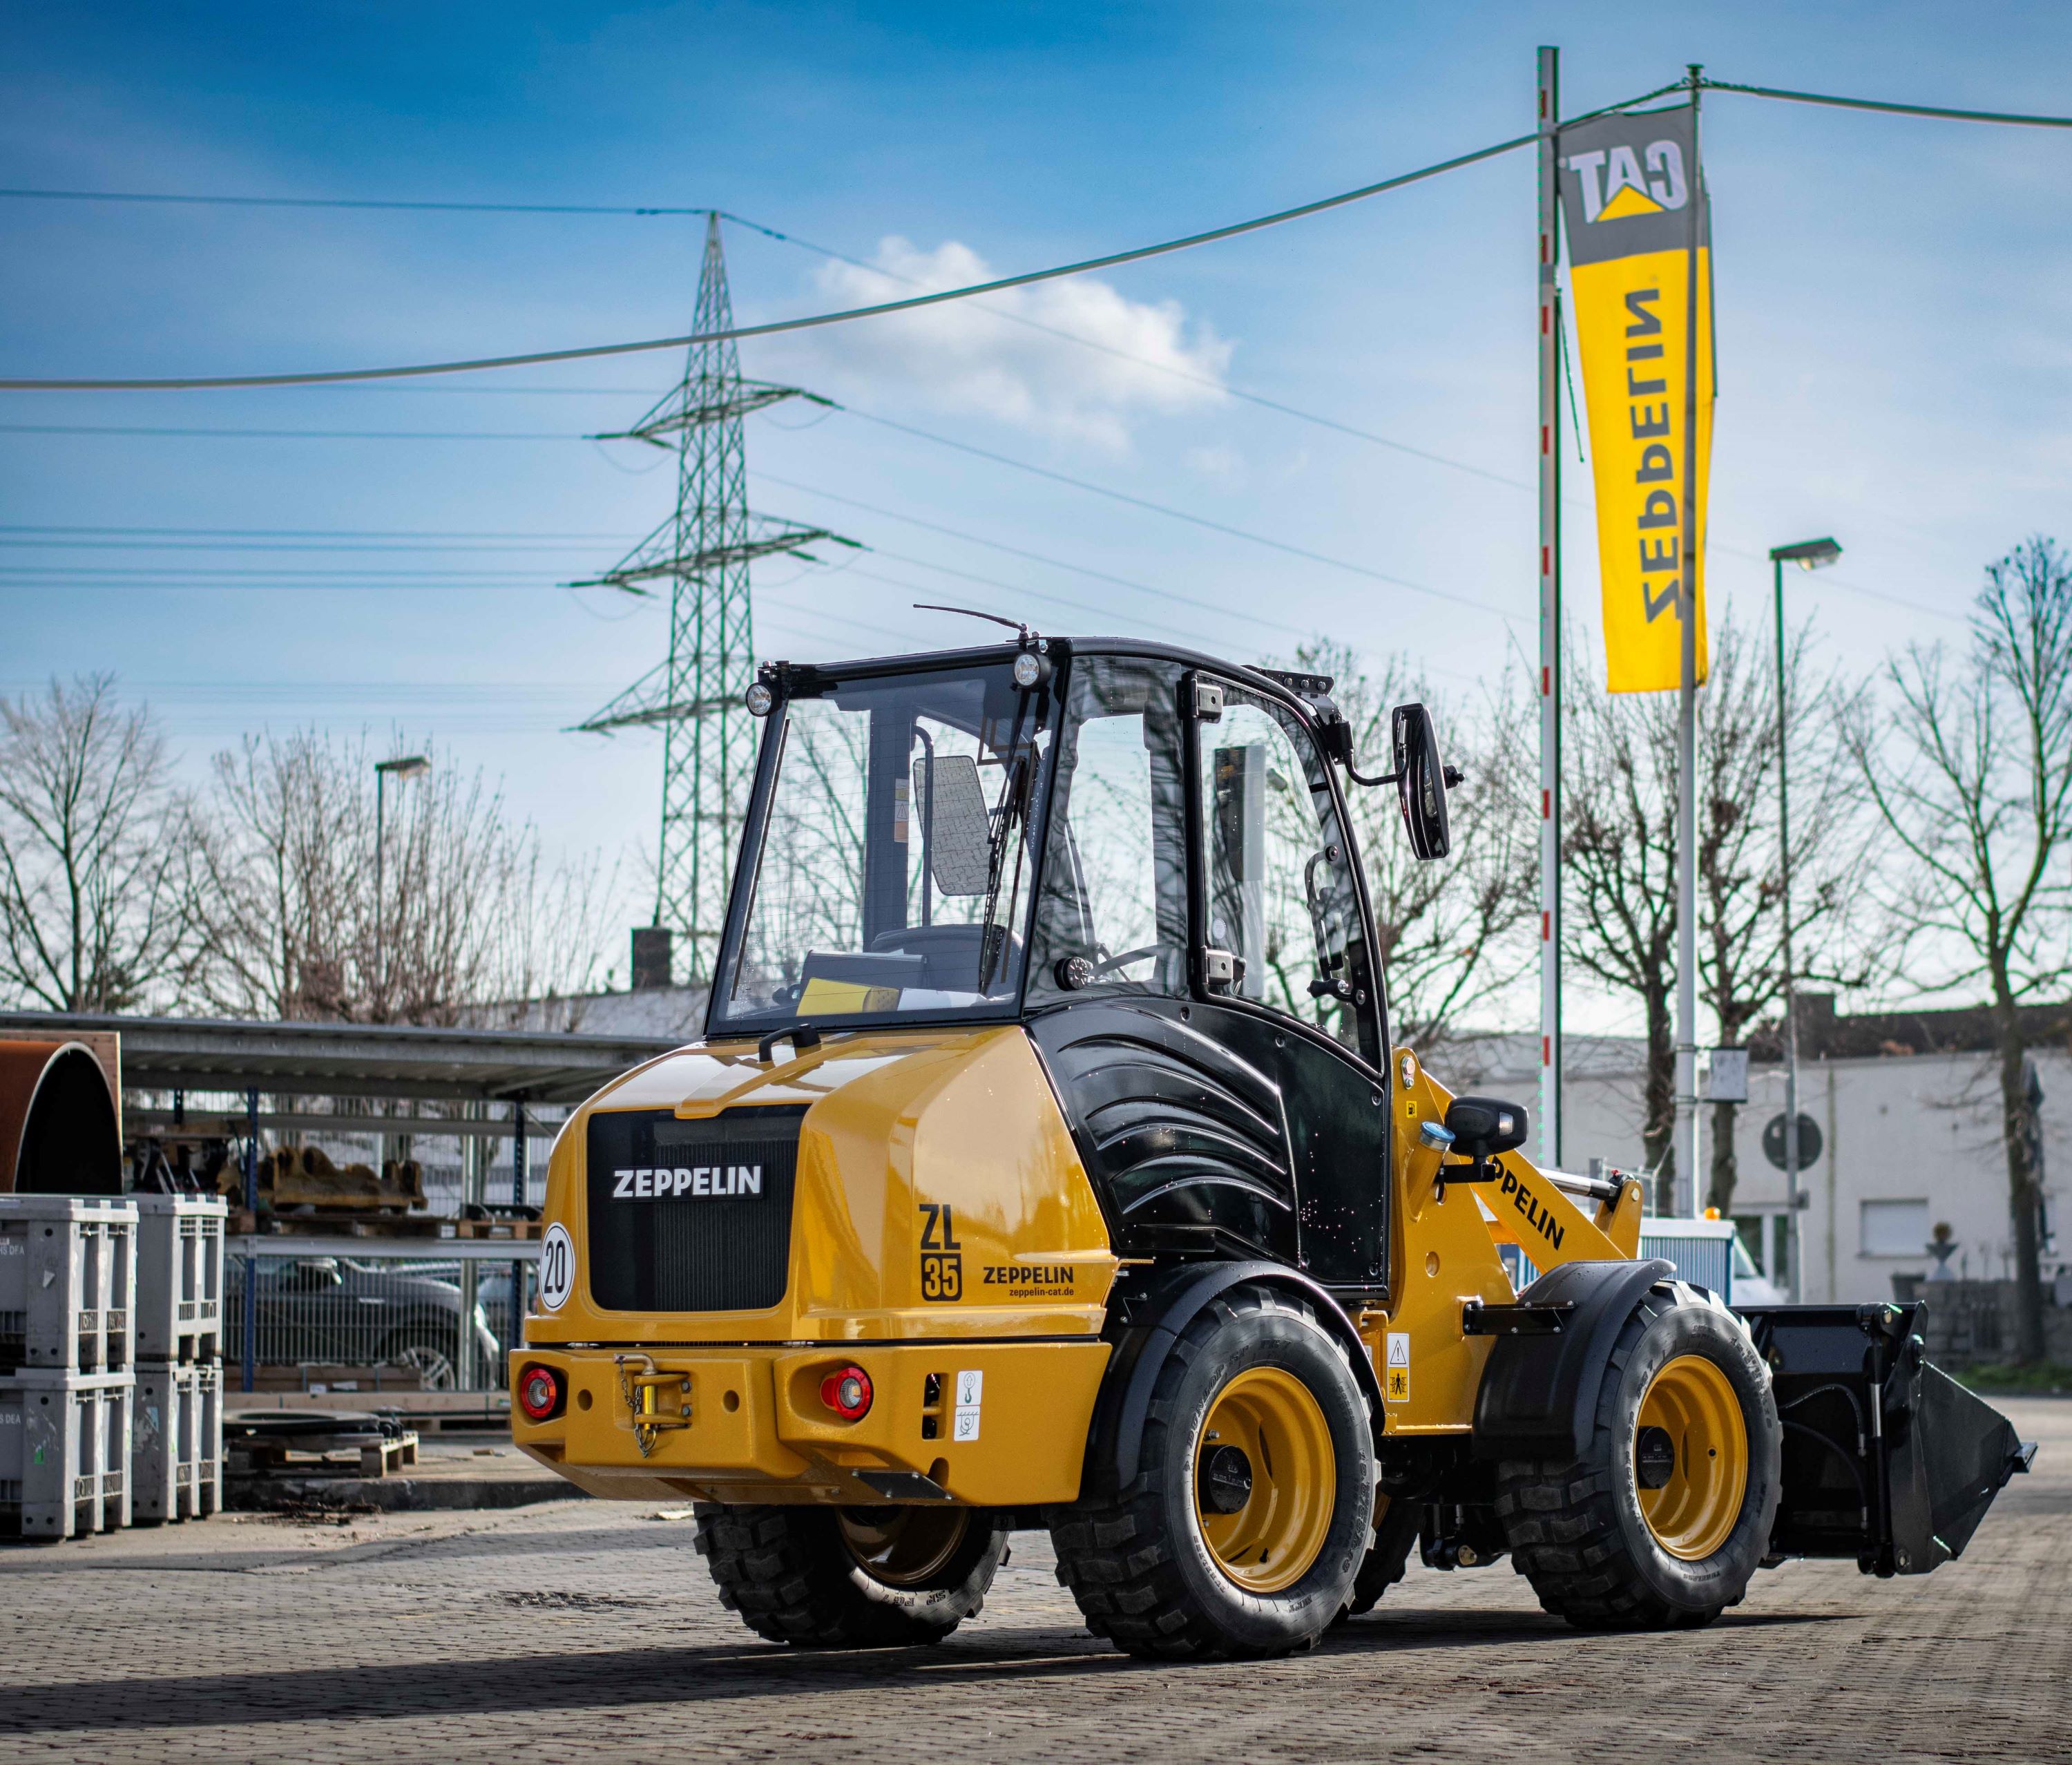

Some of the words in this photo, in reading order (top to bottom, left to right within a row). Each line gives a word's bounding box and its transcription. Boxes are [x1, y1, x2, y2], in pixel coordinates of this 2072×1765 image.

[613, 1165, 761, 1198] ZEPPELIN
[919, 1203, 961, 1250] ZL
[544, 1239, 566, 1295] 20
[924, 1257, 959, 1298] 35
[983, 1266, 1075, 1284] ZEPPELIN
[1009, 1286, 1075, 1299] zeppelin-cat.de
